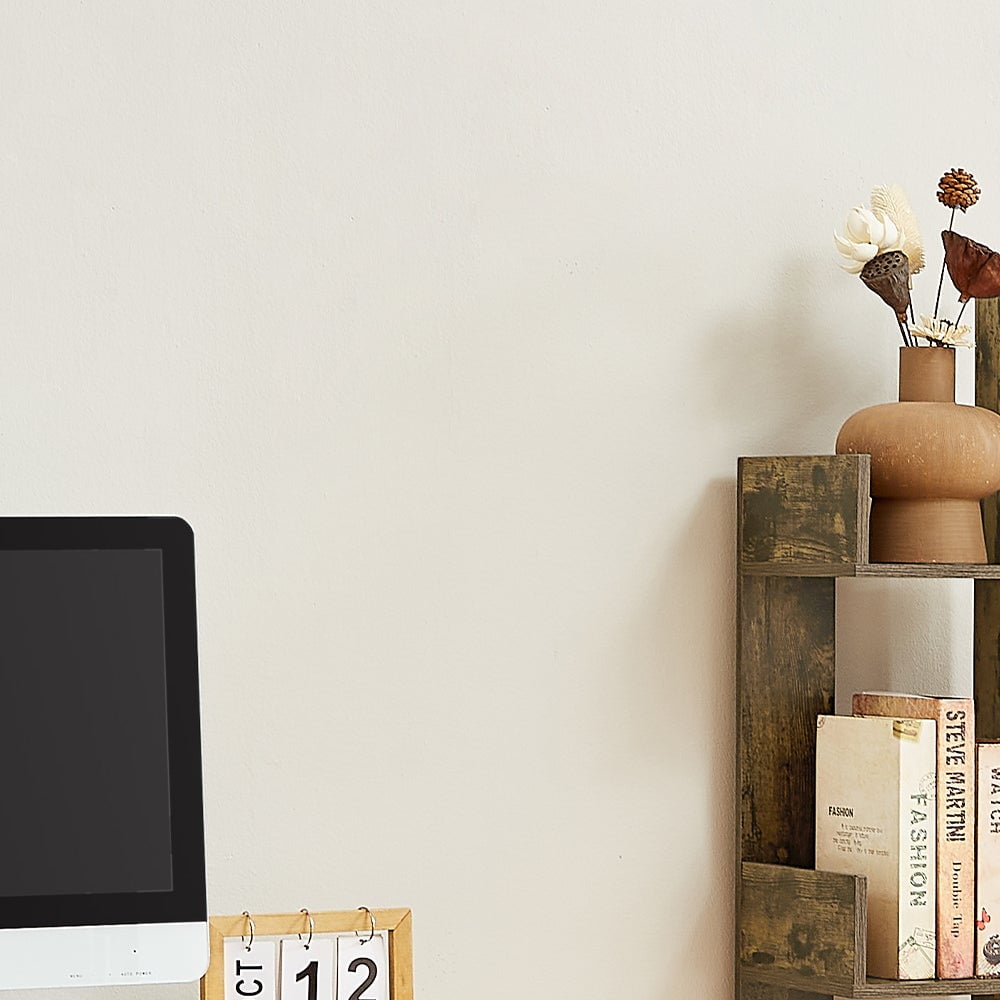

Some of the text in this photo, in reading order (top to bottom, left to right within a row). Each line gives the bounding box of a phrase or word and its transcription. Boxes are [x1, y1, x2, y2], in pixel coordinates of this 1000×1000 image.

[945, 710, 966, 842] STEVE MARTINI
[828, 806, 854, 818] FASHION
[909, 793, 928, 907] FASHION
[950, 914, 963, 938] Tap
